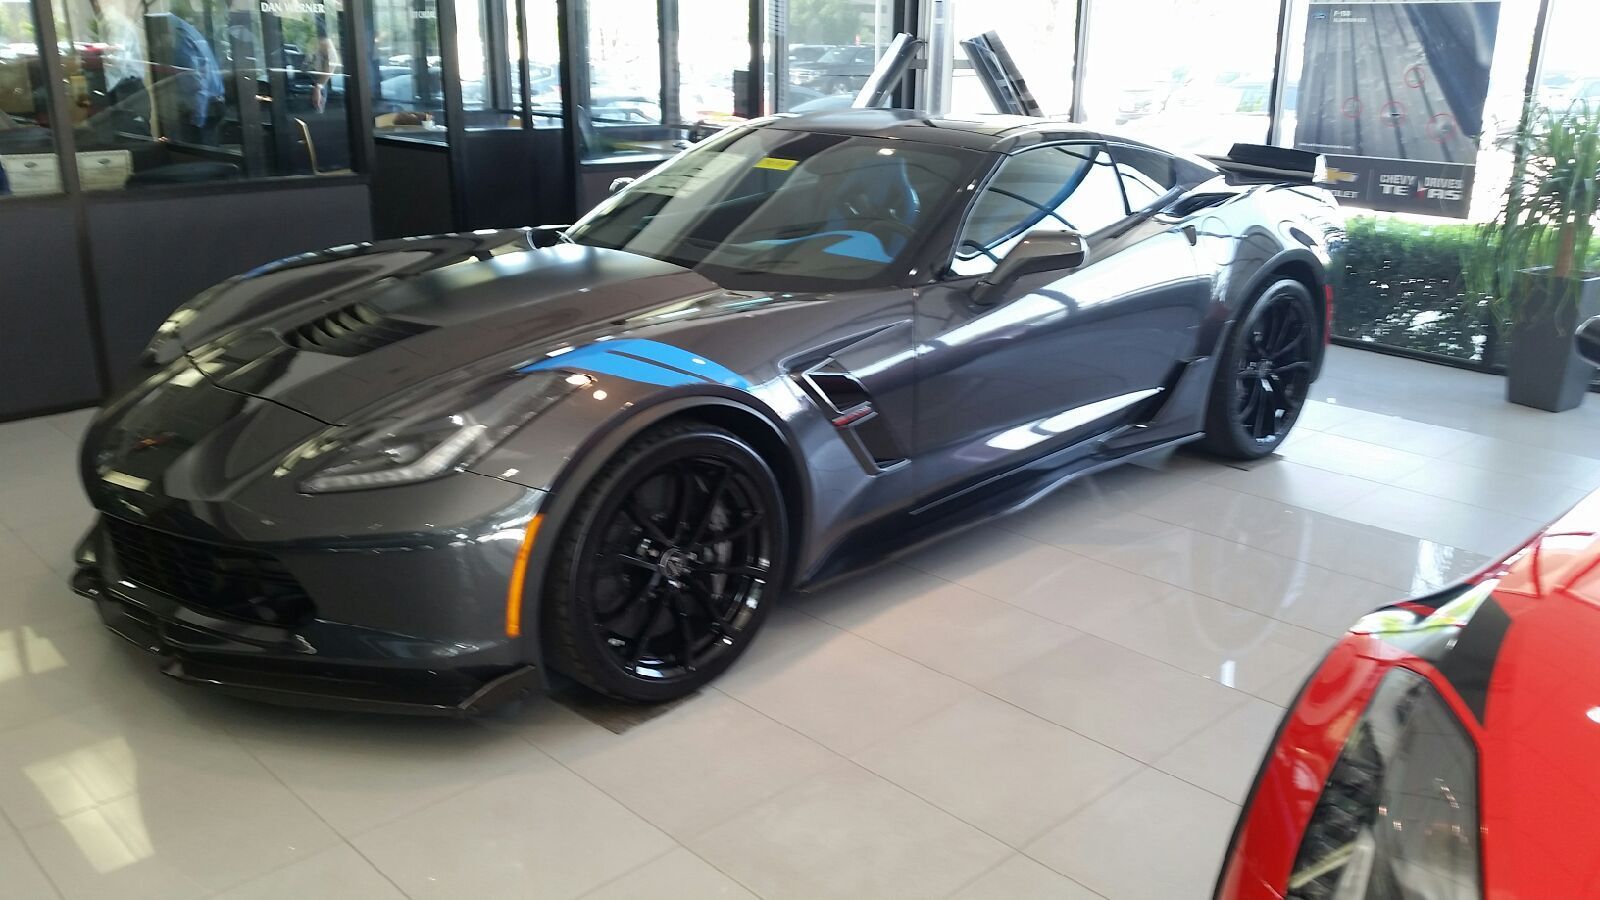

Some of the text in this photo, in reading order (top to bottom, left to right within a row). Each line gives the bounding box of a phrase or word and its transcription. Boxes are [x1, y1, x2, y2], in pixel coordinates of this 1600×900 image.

[261, 2, 281, 13] DAN
[1379, 174, 1464, 189] CHEVY DRIVES
